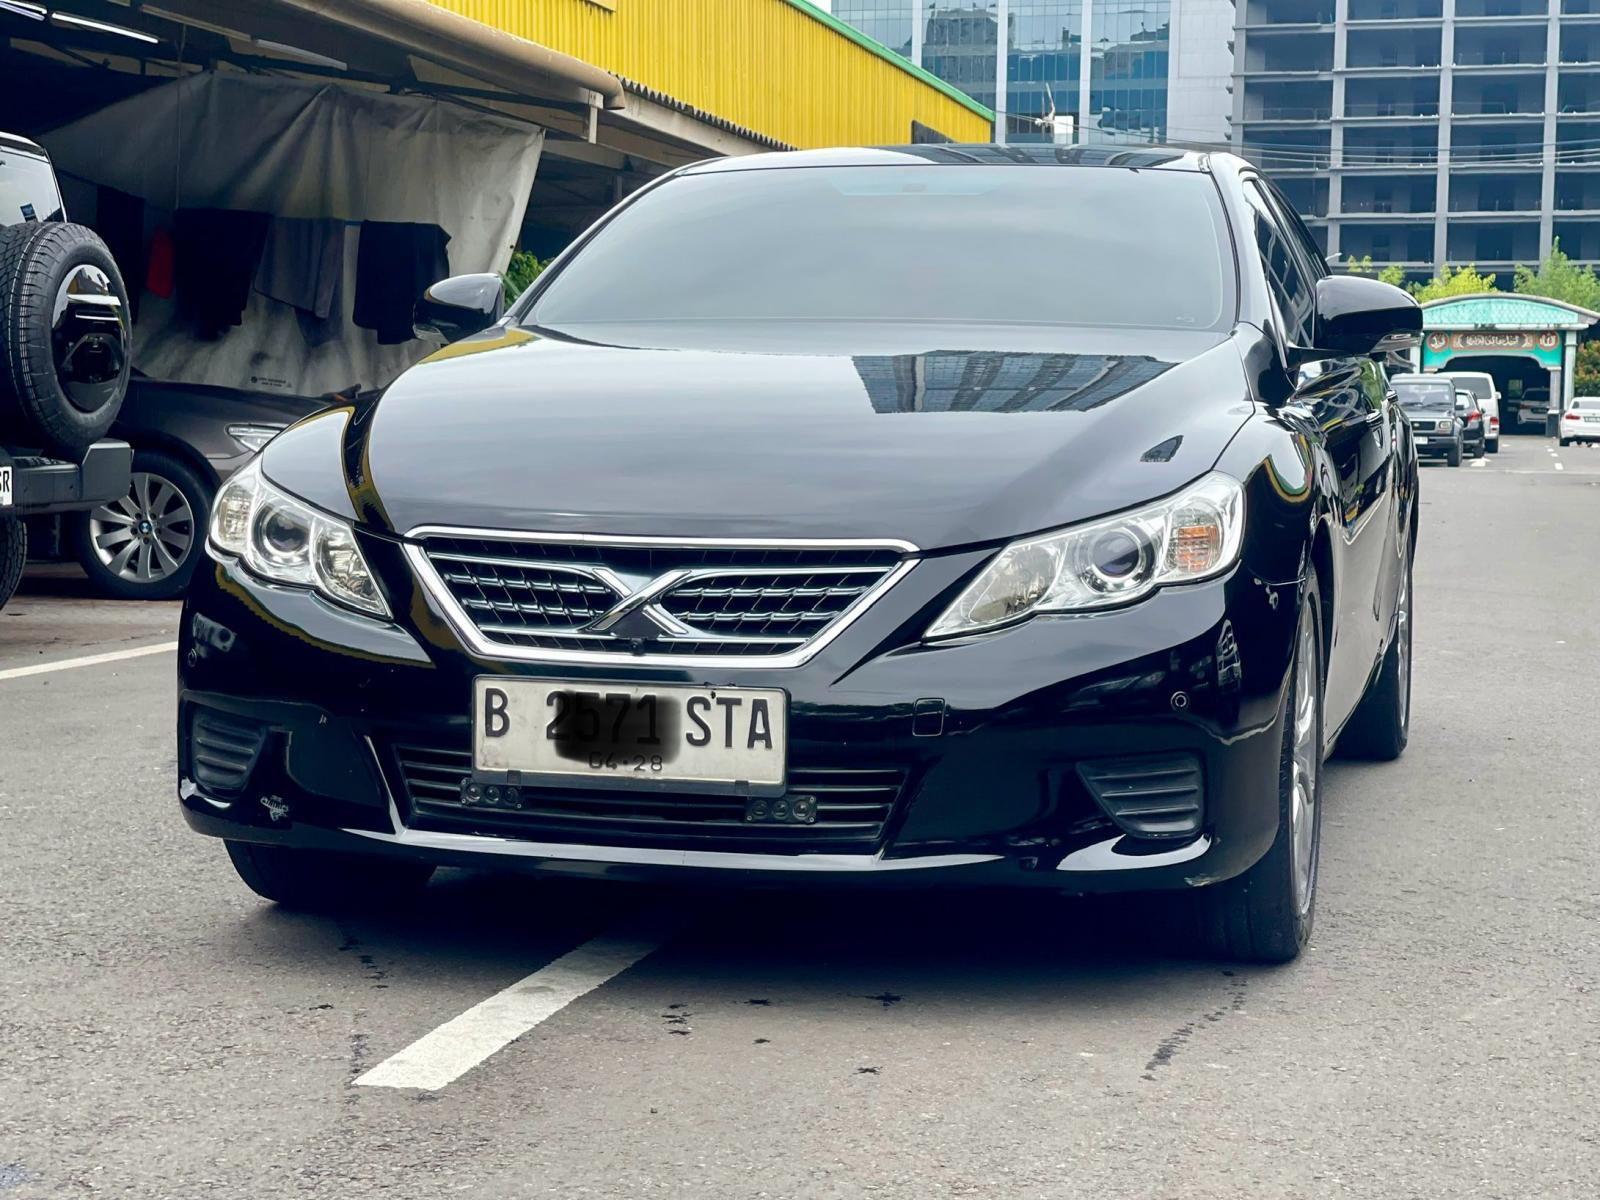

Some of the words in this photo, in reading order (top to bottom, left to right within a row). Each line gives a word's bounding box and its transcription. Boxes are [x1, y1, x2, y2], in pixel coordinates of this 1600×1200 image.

[0, 470, 10, 493] R
[485, 687, 510, 738] B
[686, 695, 773, 750] STA
